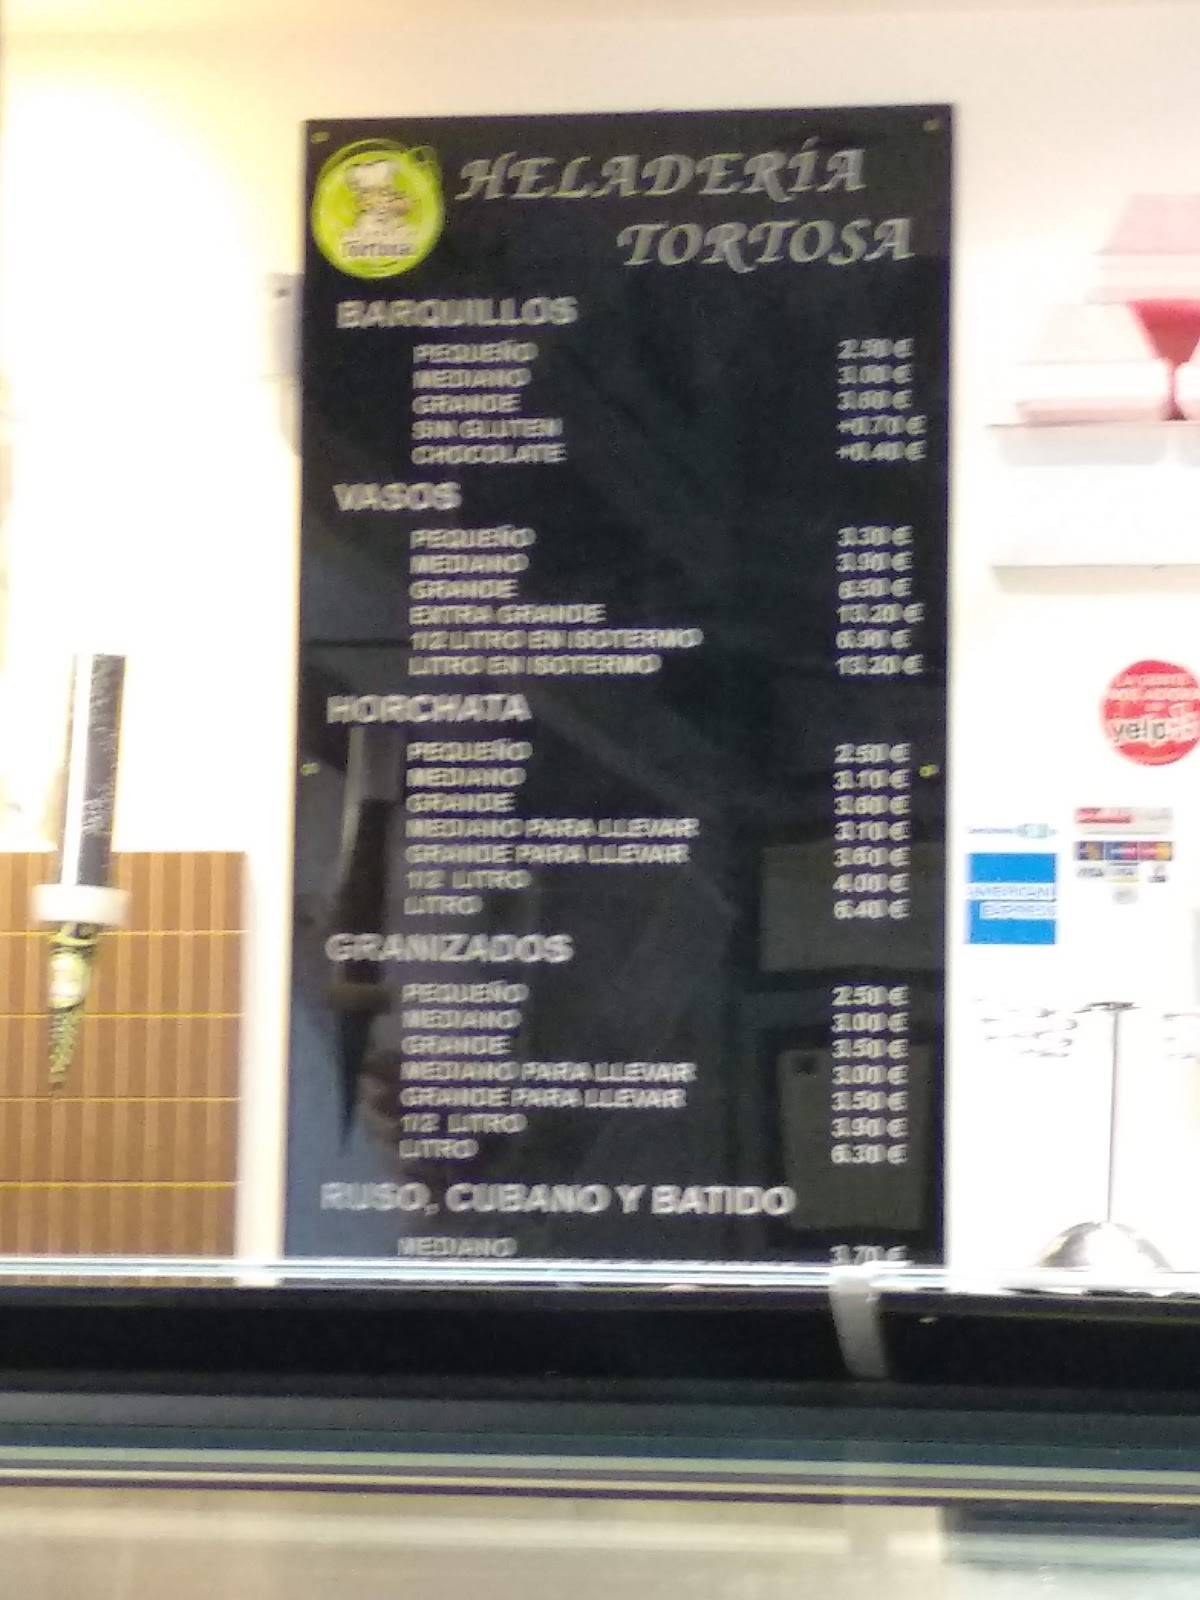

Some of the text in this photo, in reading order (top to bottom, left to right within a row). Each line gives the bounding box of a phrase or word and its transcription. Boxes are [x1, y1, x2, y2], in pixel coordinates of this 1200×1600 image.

[455, 139, 866, 202] HELADERÍA
[617, 218, 915, 273] TORTOSA
[337, 296, 578, 328] BARQUILLOS
[413, 368, 531, 389] MEDIANO
[413, 394, 521, 413] GRANDE
[412, 420, 456, 439] SIN
[458, 417, 562, 438] GLUTEN
[412, 443, 567, 464] CHOCOLATE
[333, 482, 462, 511] VASOS
[410, 554, 529, 574] MEDIANO
[409, 580, 518, 599] GRANDE
[410, 606, 493, 625] EXTRA
[495, 603, 606, 624] GRANDE
[449, 631, 526, 650] LITRO
[528, 631, 566, 649] EN
[568, 629, 704, 648] ISOTERMO
[408, 657, 486, 676] LITRO
[487, 656, 526, 675] EN
[527, 654, 662, 674] ISOTERMO
[327, 694, 532, 723] HORCHATA
[406, 768, 526, 786] MEDIANO
[406, 793, 518, 812] GRANDE
[405, 819, 523, 838] MEDIANO
[525, 818, 596, 837] PARA
[598, 817, 700, 837] LLEVAR
[404, 845, 513, 863] GRANDE
[515, 844, 586, 862] PARA
[590, 844, 689, 863] LLEVAR
[452, 870, 532, 889] LITRO
[403, 896, 483, 914] LITRO
[325, 933, 574, 963] GRANIZADOS
[402, 1009, 522, 1028] MEDIANO
[401, 1036, 511, 1055] GRANDE
[401, 1062, 519, 1081] MEDIANO
[521, 1062, 592, 1081] PARA
[594, 1062, 697, 1081] LLEVAR
[400, 1088, 510, 1107] GRANDE
[511, 1088, 583, 1107] PARA
[585, 1088, 687, 1107] LLEVAR
[448, 1114, 527, 1133] LITRO
[399, 1139, 478, 1158] LITRO
[320, 1182, 796, 1216] RUSO, CUBANO Y BATIDO
[398, 1236, 517, 1257] MEDIANO
